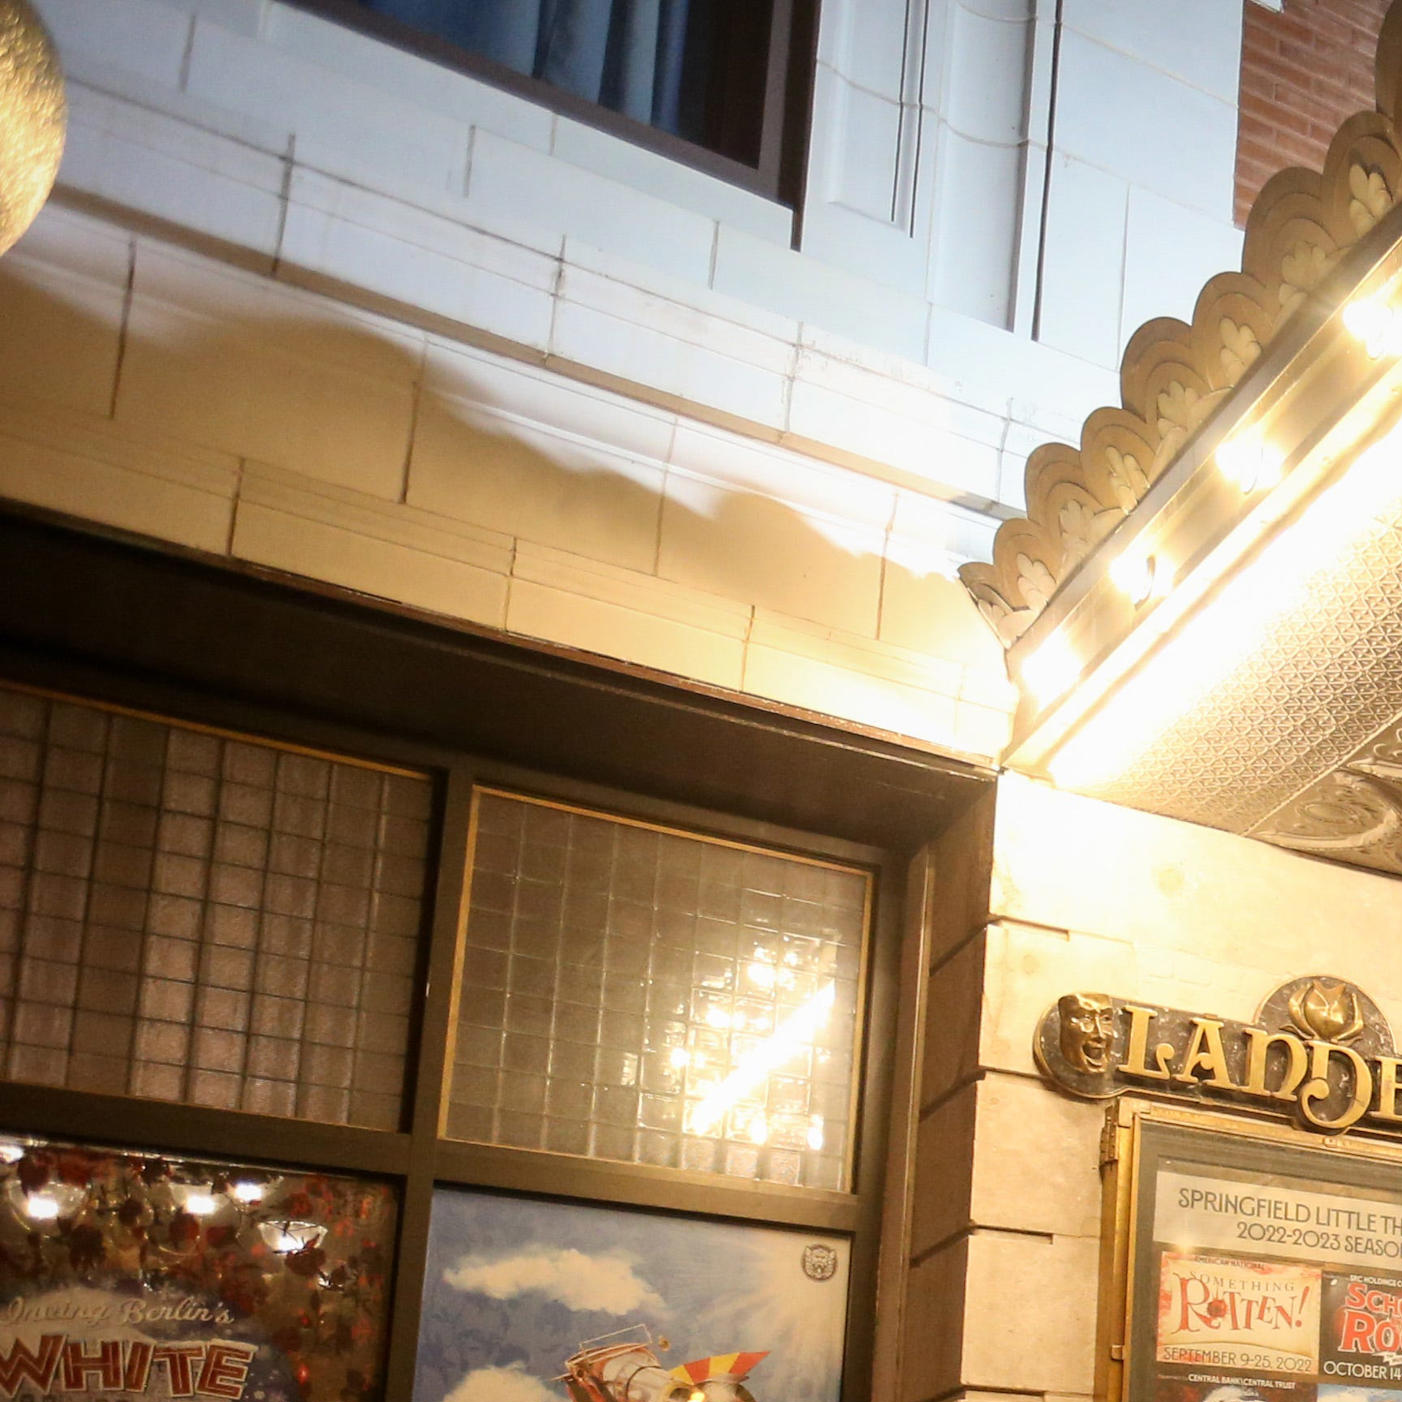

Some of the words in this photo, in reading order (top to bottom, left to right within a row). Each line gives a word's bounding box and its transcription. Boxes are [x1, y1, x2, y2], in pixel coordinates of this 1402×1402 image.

[1178, 1187, 1312, 1224] SPRINGFIELD
[1315, 1206, 1377, 1233] LITTLE
[1236, 1221, 1342, 1251] 2022-2023
[1190, 1271, 1296, 1292] SOMETHING
[120, 1295, 236, 1325] Berlin's
[1171, 1272, 1310, 1334] ROTTEN!
[0, 1333, 259, 1400] WHITE
[1163, 1346, 1237, 1366] SEPTEMBER
[1275, 1356, 1312, 1373] 2022
[1323, 1360, 1388, 1380] OCTOBER
